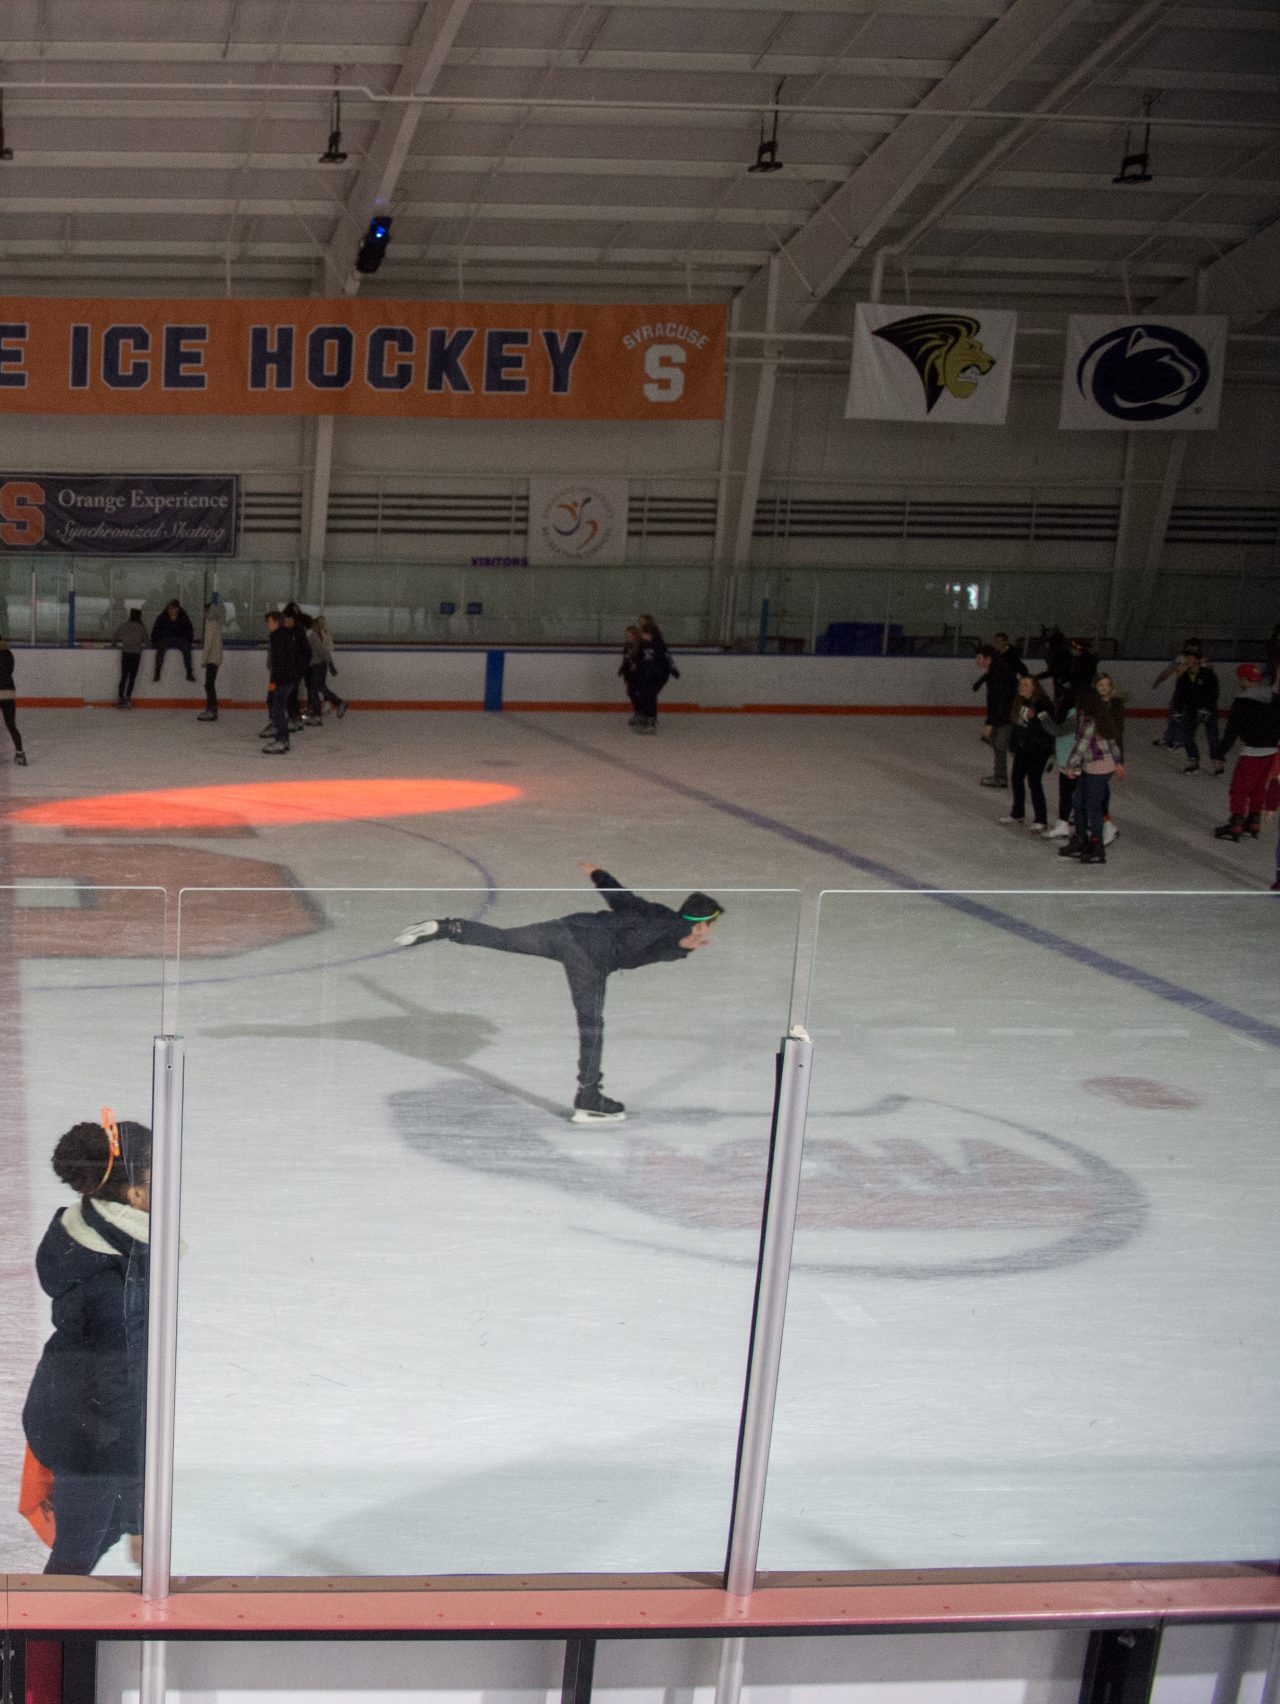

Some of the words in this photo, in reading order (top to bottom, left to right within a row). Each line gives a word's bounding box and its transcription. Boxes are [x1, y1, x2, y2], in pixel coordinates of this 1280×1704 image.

[622, 322, 710, 350] SYRACUSE
[69, 322, 209, 391] ICE
[248, 324, 586, 396] HOCKEY
[643, 343, 688, 403] S
[58, 489, 125, 513] Orange
[130, 489, 229, 514] Experience
[56, 521, 164, 544] Synchronized
[164, 522, 225, 545] Skating
[471, 556, 529, 567] VISITORS
